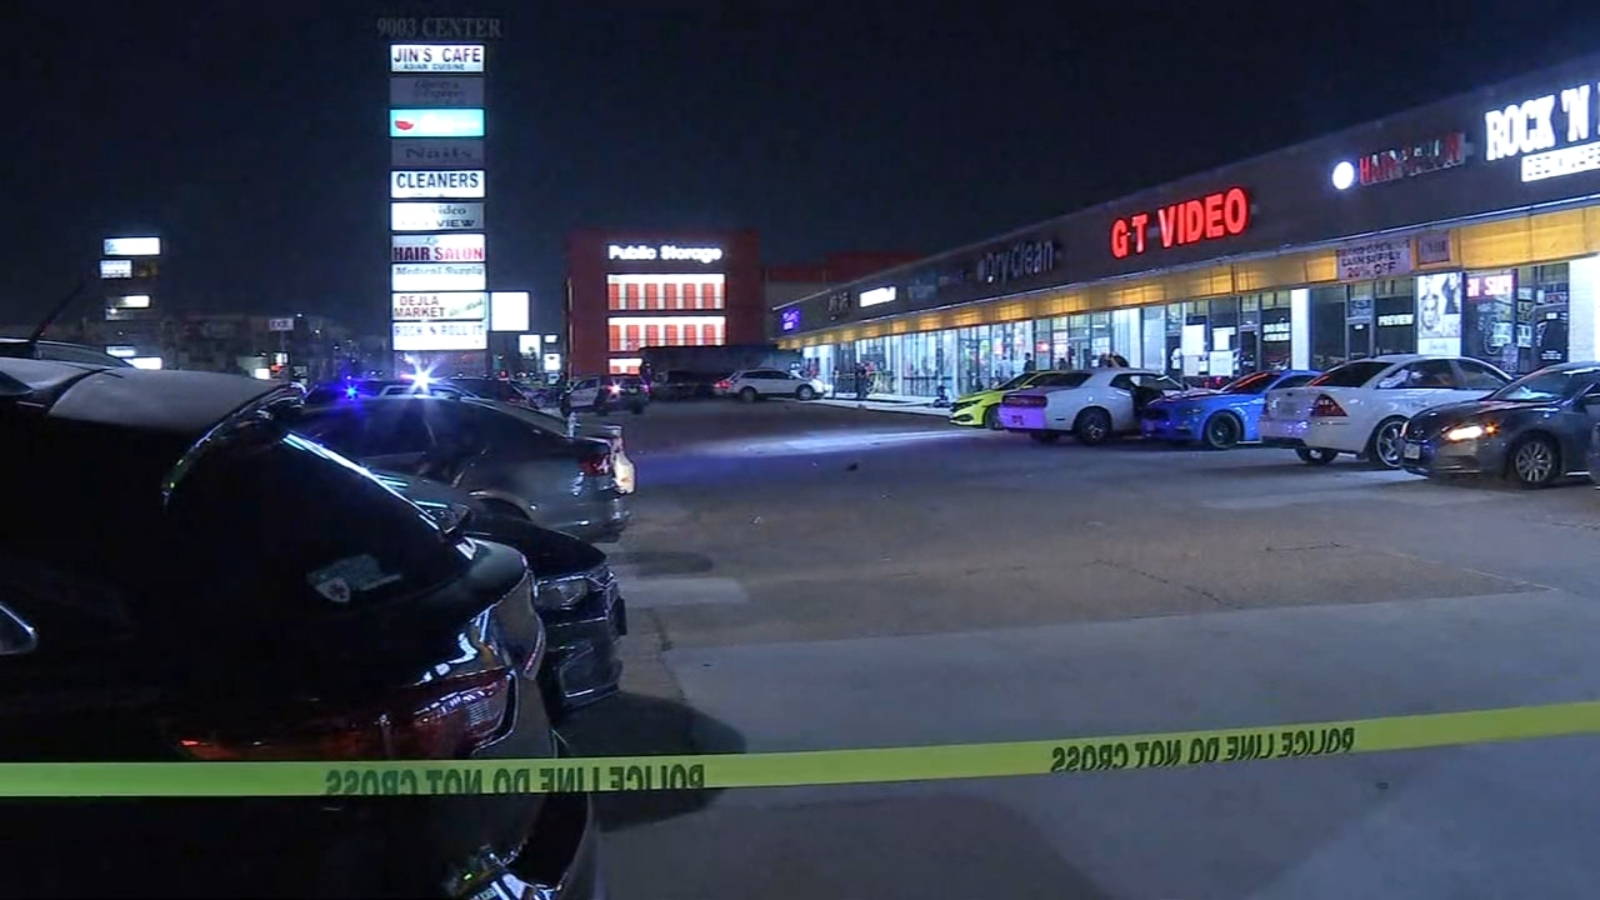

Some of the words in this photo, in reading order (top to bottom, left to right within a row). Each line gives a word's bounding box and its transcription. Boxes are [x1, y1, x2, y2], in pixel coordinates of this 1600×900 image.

[377, 17, 416, 38] 9003
[421, 17, 503, 38] CENTER
[393, 48, 432, 63] JIN'S
[441, 48, 481, 63] CAFE
[403, 63, 428, 71] ASIAN
[431, 63, 466, 71] CUISINE
[1486, 95, 1555, 160] ROCK
[395, 172, 479, 189] CLEANERS
[1157, 187, 1247, 248] VIDEO
[393, 246, 431, 261] HAIR
[434, 246, 483, 261] SALON
[609, 244, 657, 260] Public
[660, 244, 722, 264] Storage
[399, 295, 440, 306] DEJLA
[393, 306, 447, 318] MARKET
